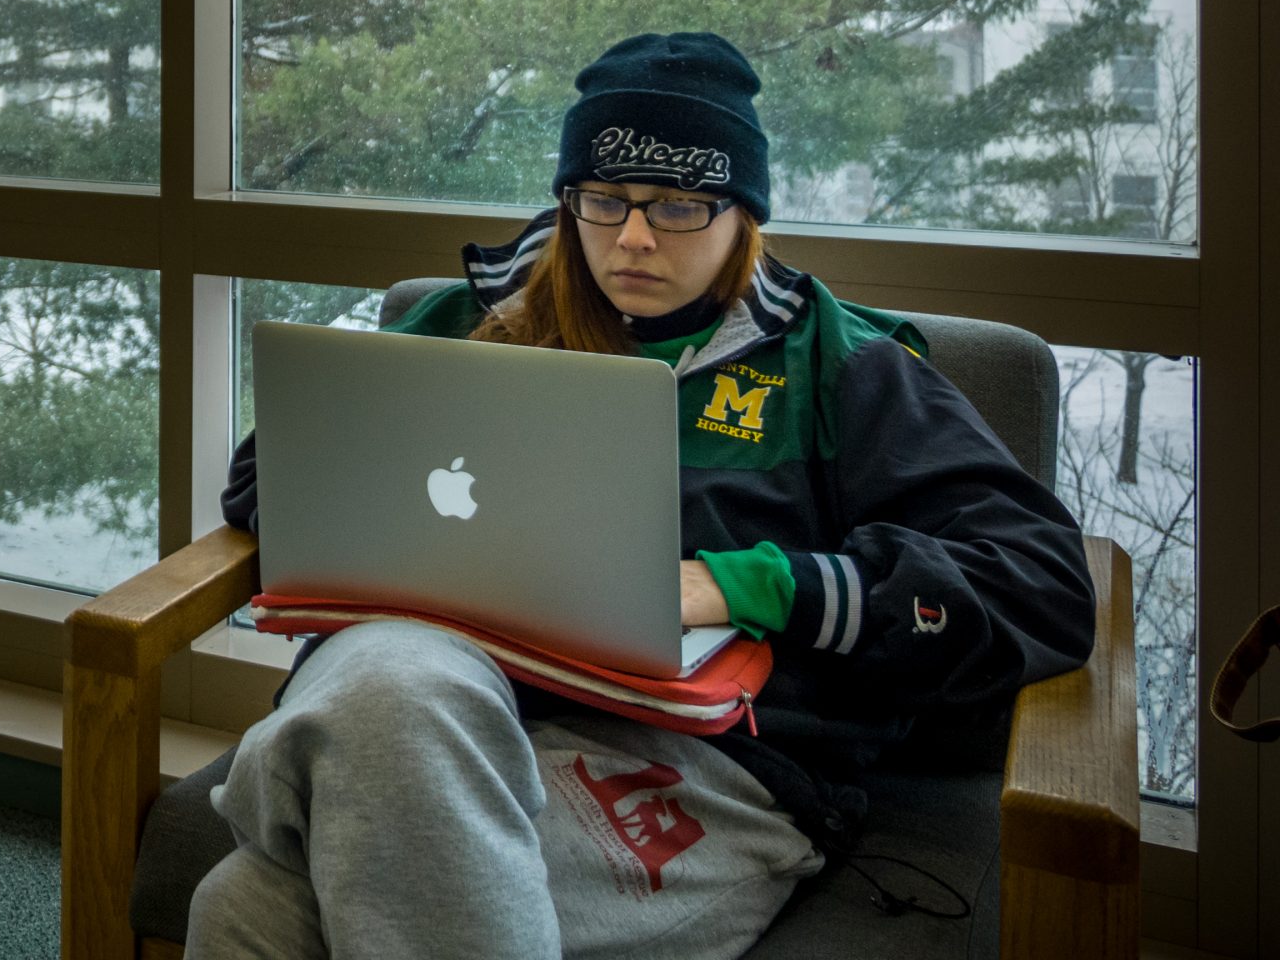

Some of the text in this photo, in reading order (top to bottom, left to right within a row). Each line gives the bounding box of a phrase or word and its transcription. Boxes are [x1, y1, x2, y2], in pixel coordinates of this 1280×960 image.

[591, 127, 730, 189] Chicago
[703, 373, 772, 430] M
[695, 417, 765, 444] HOCKEY
[561, 763, 602, 819] Eleventh
